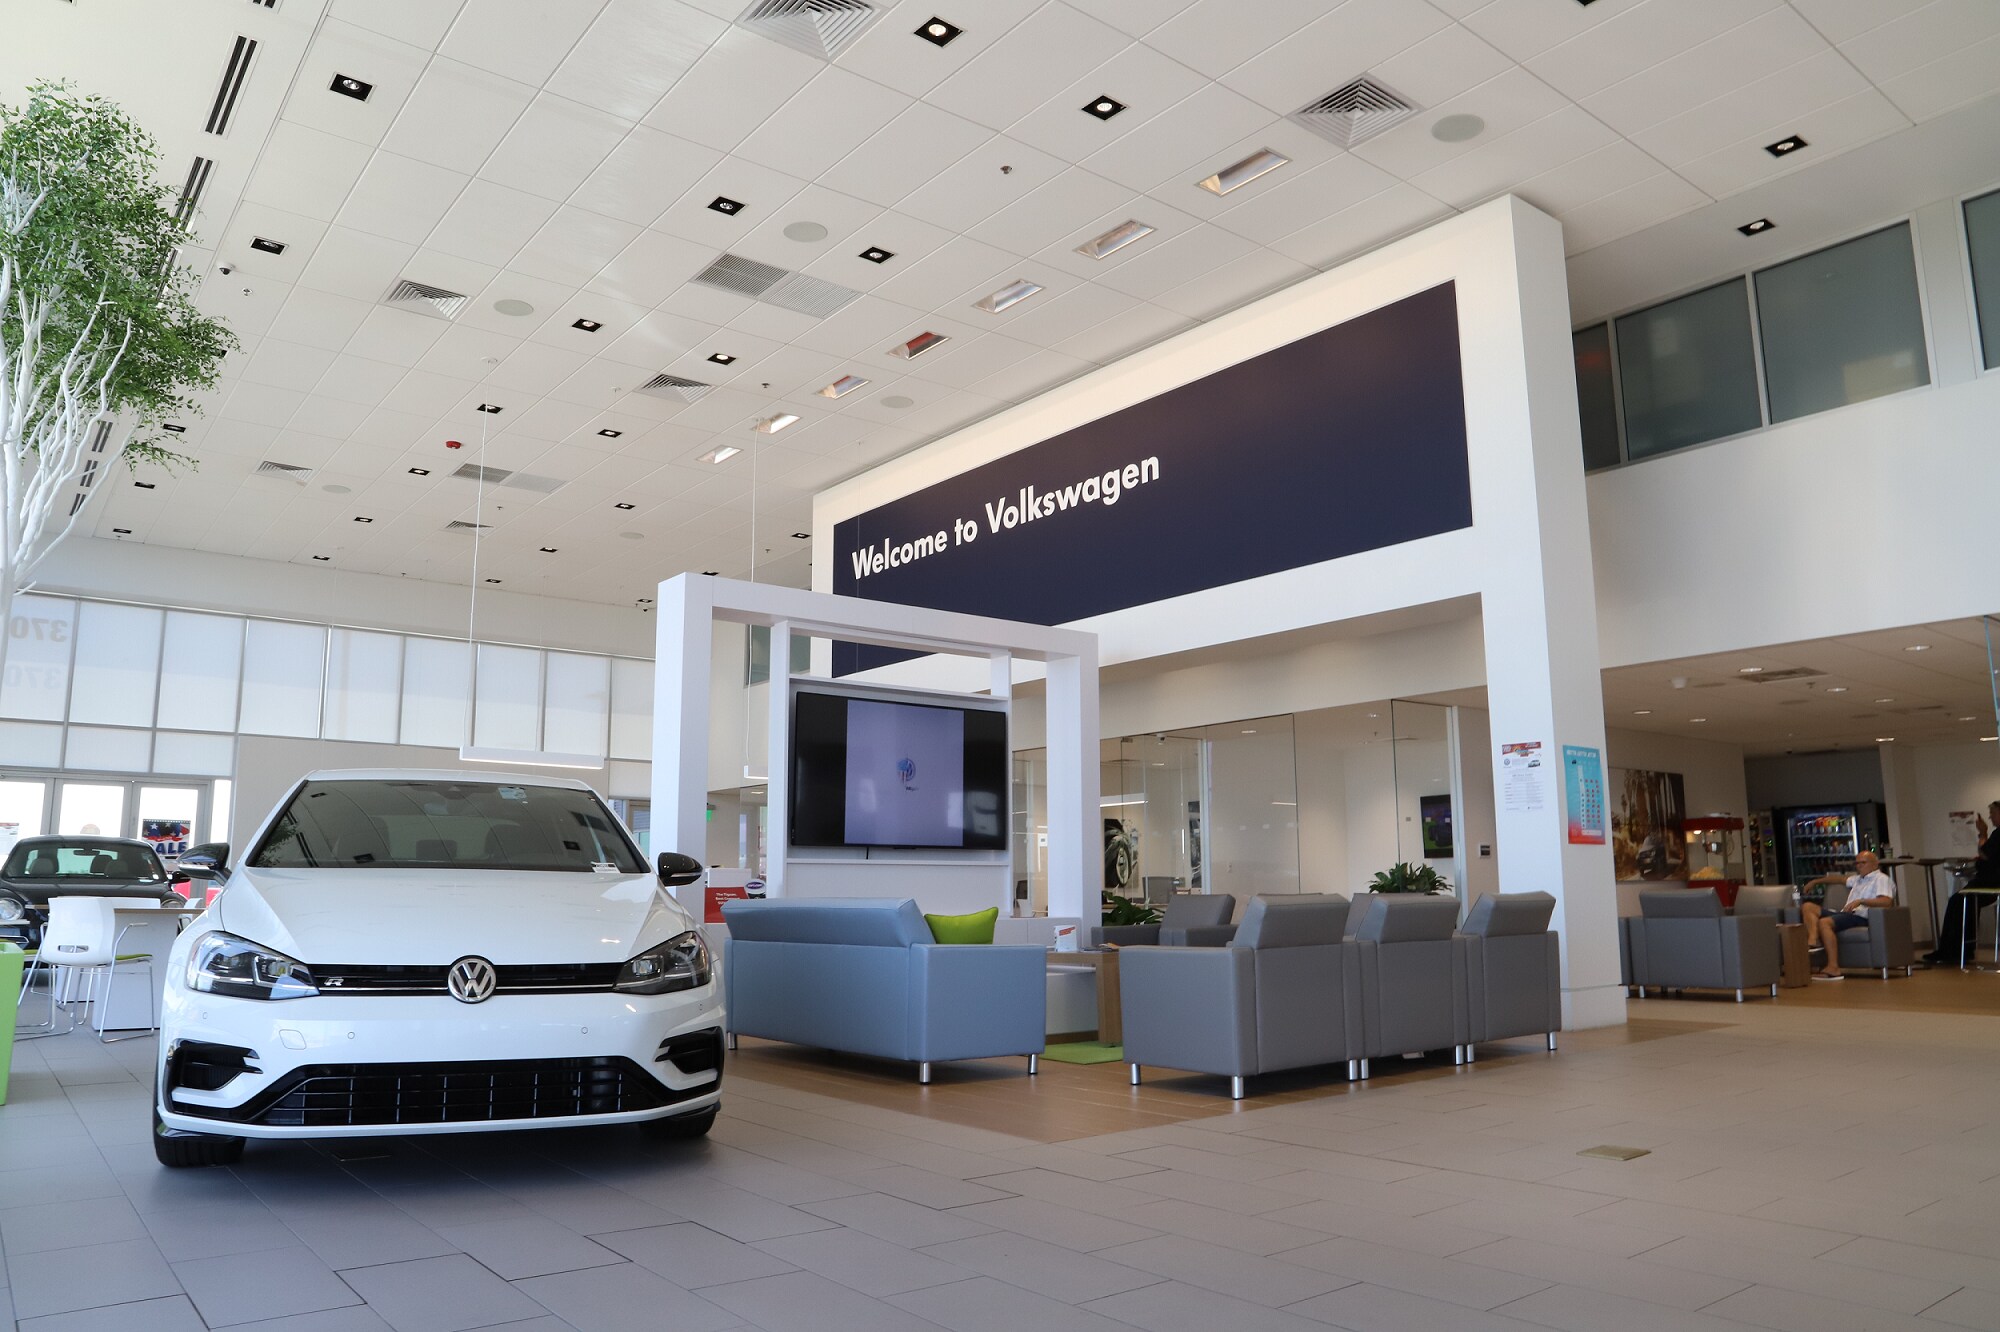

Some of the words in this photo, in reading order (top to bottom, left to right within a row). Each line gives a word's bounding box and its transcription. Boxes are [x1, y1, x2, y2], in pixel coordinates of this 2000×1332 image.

[851, 529, 948, 580] Welcome
[954, 518, 978, 546] to
[984, 456, 1160, 534] Volkswagen
[150, 841, 188, 855] ALE
